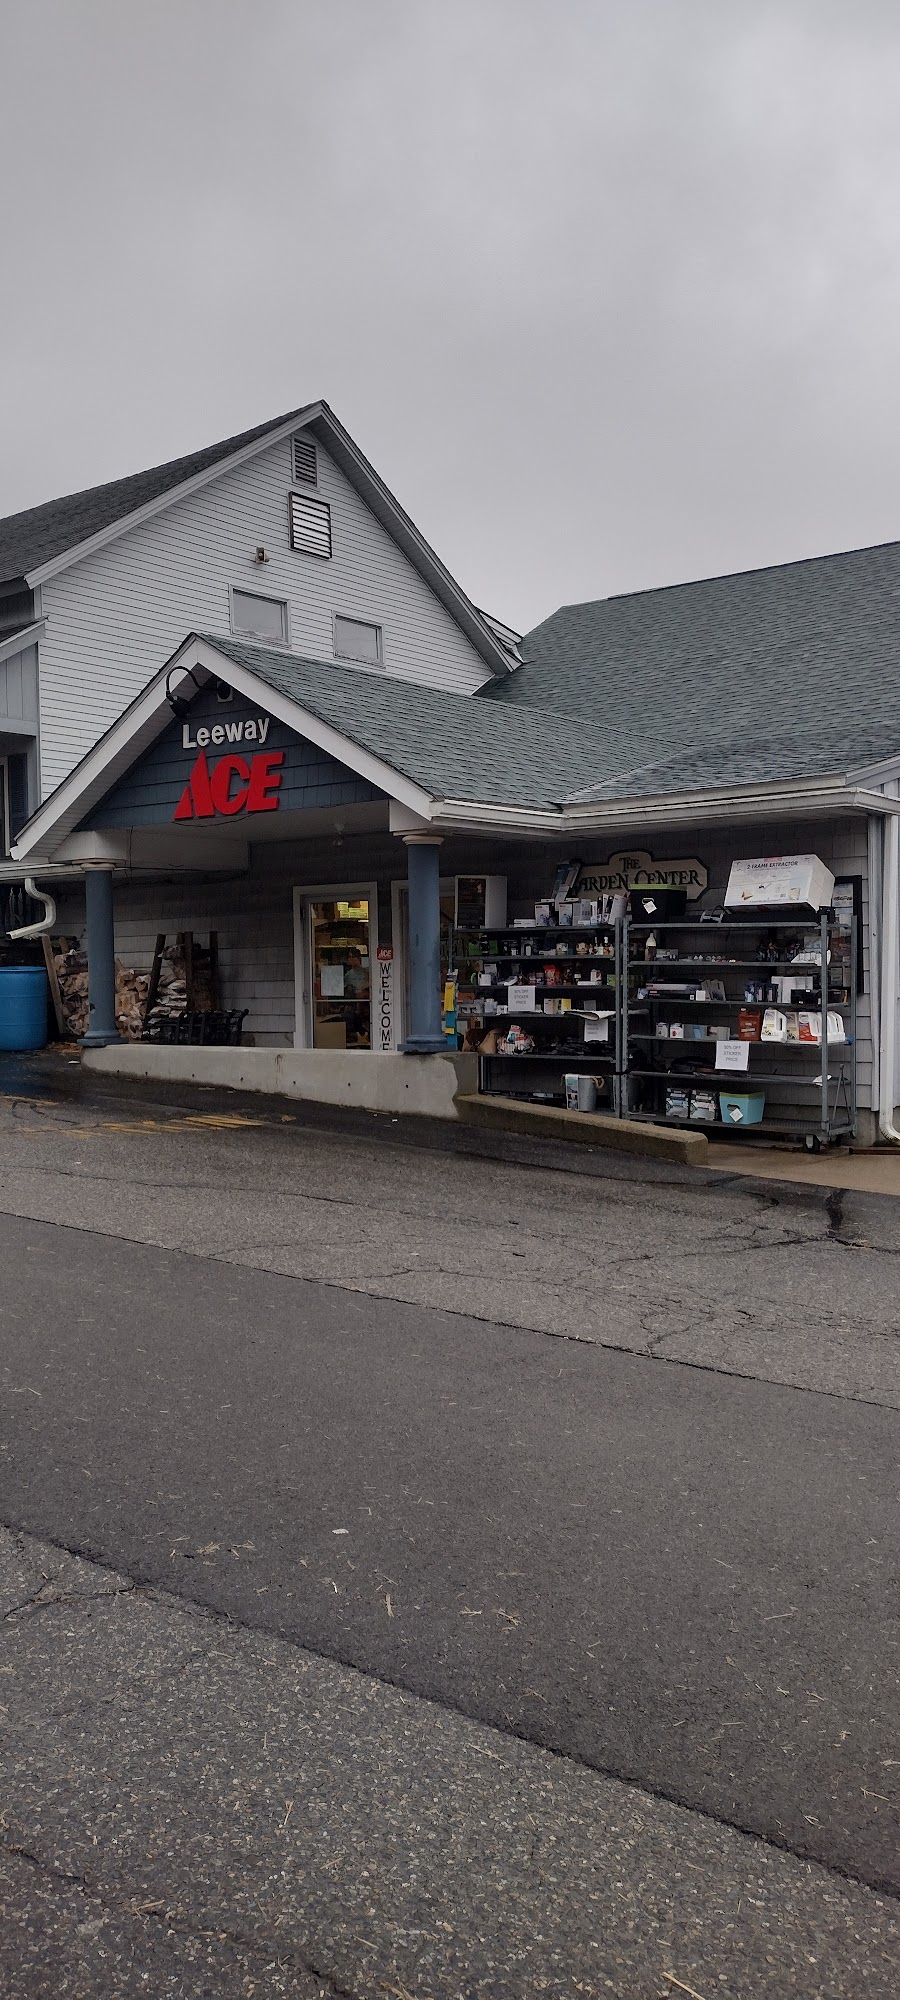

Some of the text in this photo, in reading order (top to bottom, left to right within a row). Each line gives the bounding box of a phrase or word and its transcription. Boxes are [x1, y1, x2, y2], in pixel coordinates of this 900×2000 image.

[182, 718, 269, 748] Leeway
[174, 748, 284, 818] ACE
[769, 860, 798, 868] EXTRACTOR
[576, 869, 702, 892] ARDEN CENTER
[378, 950, 392, 958] ACE
[380, 962, 391, 1050] WELCOME
